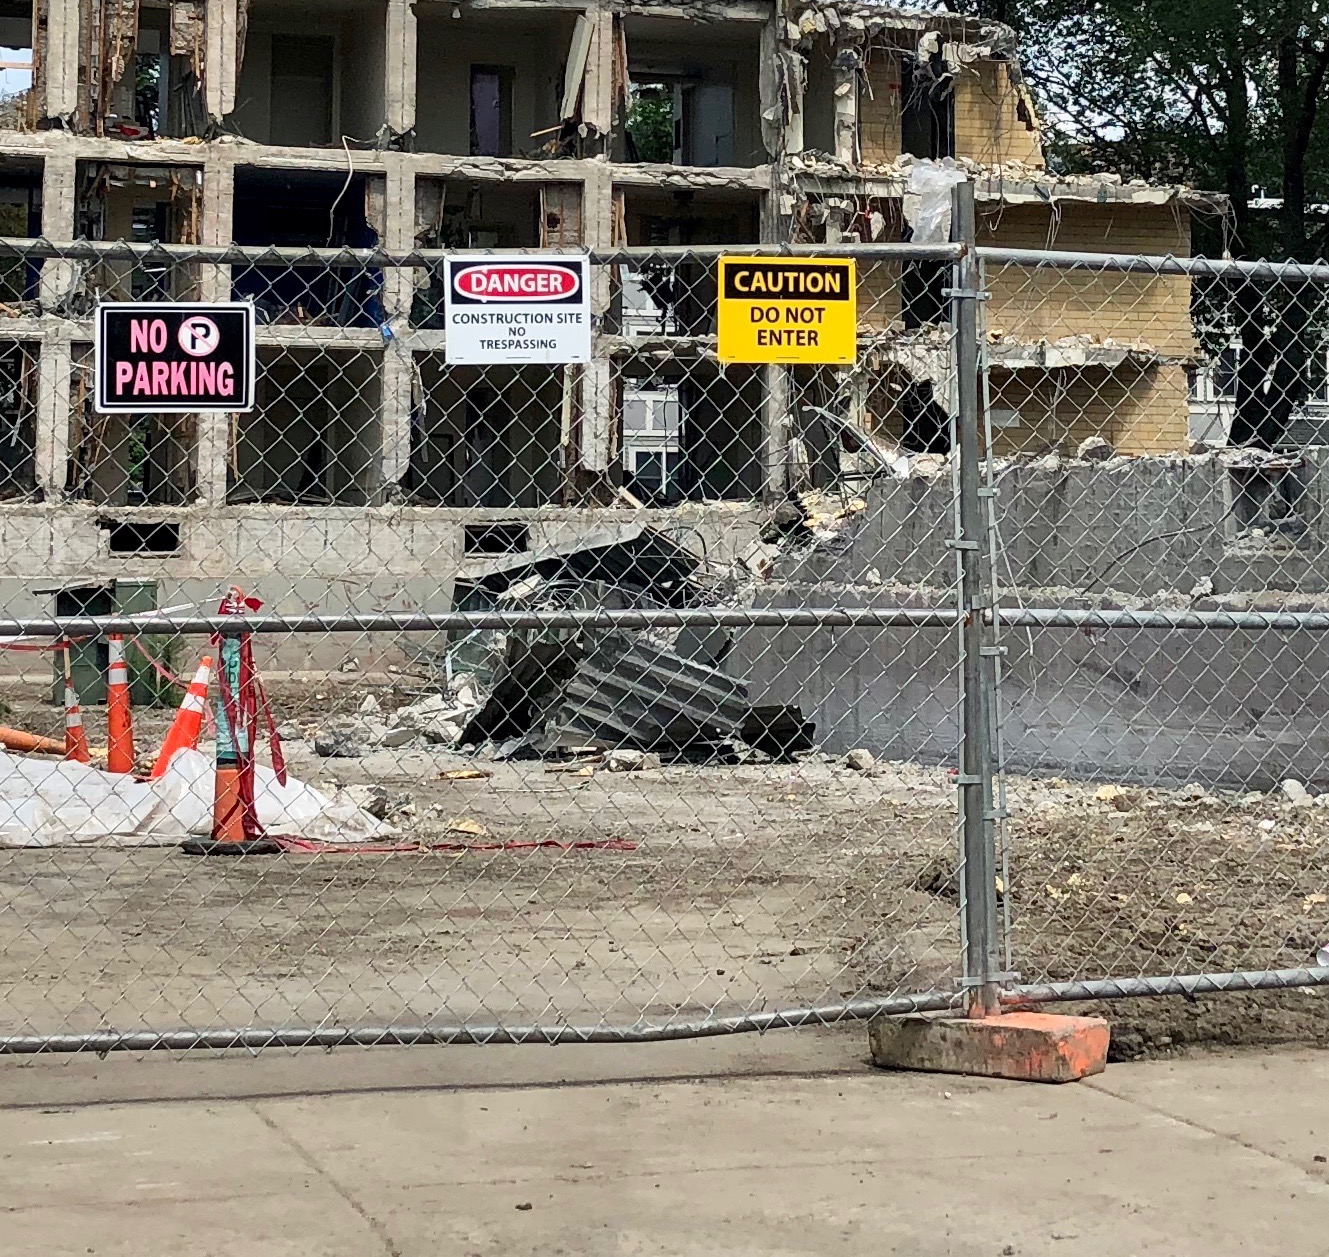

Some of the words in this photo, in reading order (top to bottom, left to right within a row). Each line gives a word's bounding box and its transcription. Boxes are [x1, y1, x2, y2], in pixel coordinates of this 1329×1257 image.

[471, 273, 563, 293] DANGER
[734, 270, 841, 293] CAUTION
[452, 313, 554, 325] CONSTRUCTION
[556, 312, 583, 324] SITE
[750, 307, 780, 323] DO
[786, 307, 826, 324] NOT
[130, 318, 168, 354] NO
[508, 327, 526, 337] NO
[757, 329, 819, 347] ENTER
[479, 339, 557, 350] TRESPASSING
[115, 361, 235, 397] PARKING
